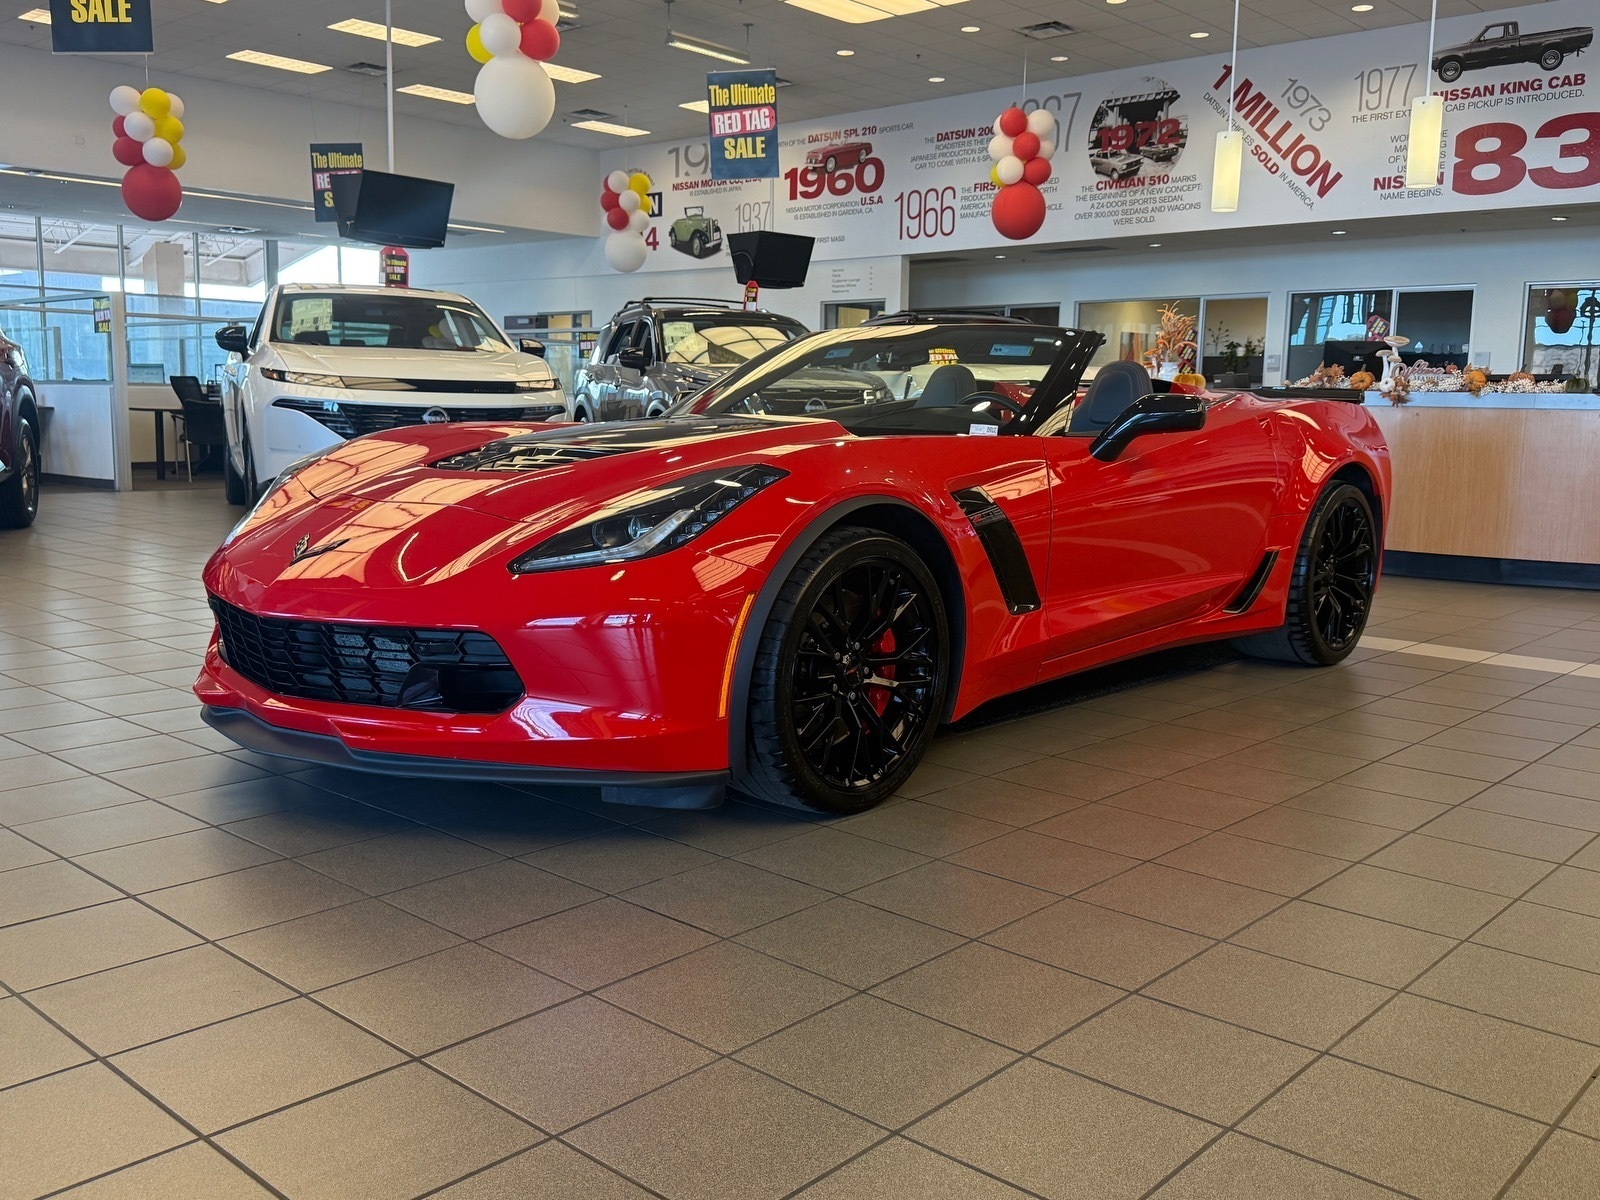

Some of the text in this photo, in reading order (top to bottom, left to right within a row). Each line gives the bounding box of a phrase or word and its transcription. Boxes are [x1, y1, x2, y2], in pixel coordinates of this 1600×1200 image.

[71, 0, 132, 23] SALE
[1354, 63, 1418, 113] 1977
[1500, 79, 1543, 95] KING
[1548, 73, 1586, 90] CAB
[709, 83, 776, 107] The Ultimate
[1281, 77, 1332, 132] 1973
[1445, 89, 1585, 113] CAB PICKUP IS INTRODUCED.
[1203, 92, 1228, 119] DATSUN
[714, 108, 771, 135] RED TAG
[1351, 114, 1368, 124] THE
[1369, 111, 1394, 122] FIRST
[808, 130, 842, 144] DATSUN
[844, 129, 860, 139] SPL
[861, 126, 877, 136] 210
[878, 125, 901, 134] SPORTS
[924, 137, 935, 145] THE
[936, 128, 976, 143] DATSUN
[1097, 118, 1181, 152] 1972
[1213, 64, 1344, 199] 1 MILLION
[724, 136, 766, 160] SALE
[935, 141, 966, 152] ROADSTER
[974, 138, 985, 146] THE
[938, 148, 977, 159] PRODUCTION
[1452, 112, 1600, 196] 83
[312, 152, 363, 169] The Ultimate
[915, 162, 927, 171] CAR
[928, 161, 936, 169] TO
[937, 159, 954, 168] COME
[955, 157, 971, 166] WITH
[1251, 144, 1280, 176] SOLD
[1278, 171, 1289, 183] IN
[1388, 155, 1401, 164] OF
[316, 172, 331, 189] RE
[672, 181, 700, 192] NISSAN
[784, 156, 885, 200] 1960
[973, 181, 1001, 193] FIRS
[1081, 174, 1197, 193] THE CIVILIAN 510 MARKS
[1373, 171, 1445, 191] NISN
[960, 192, 997, 203] PRODUCTIO
[1075, 195, 1088, 203] THE
[1089, 191, 1127, 202] BEGINNING
[1128, 189, 1138, 198] OF
[1139, 188, 1145, 196] A
[1146, 186, 1164, 196] NEW
[1128, 196, 1157, 207] SPORTS
[1380, 188, 1444, 201] NAME BEGINS.
[786, 195, 883, 215] NISSAN MOTOR CORPORATION U.S.A
[894, 186, 956, 240] 1966
[960, 202, 986, 212] AMERICA
[1074, 211, 1093, 221] OVER
[1121, 206, 1149, 216] SEDANS
[1150, 205, 1166, 214] AND
[1167, 202, 1202, 212] WAGONS
[736, 201, 771, 233] 1937
[799, 210, 831, 221] ESTABLISHED
[832, 209, 838, 217] IN
[1113, 218, 1134, 226] WERE
[816, 235, 846, 244] FIRST MASS
